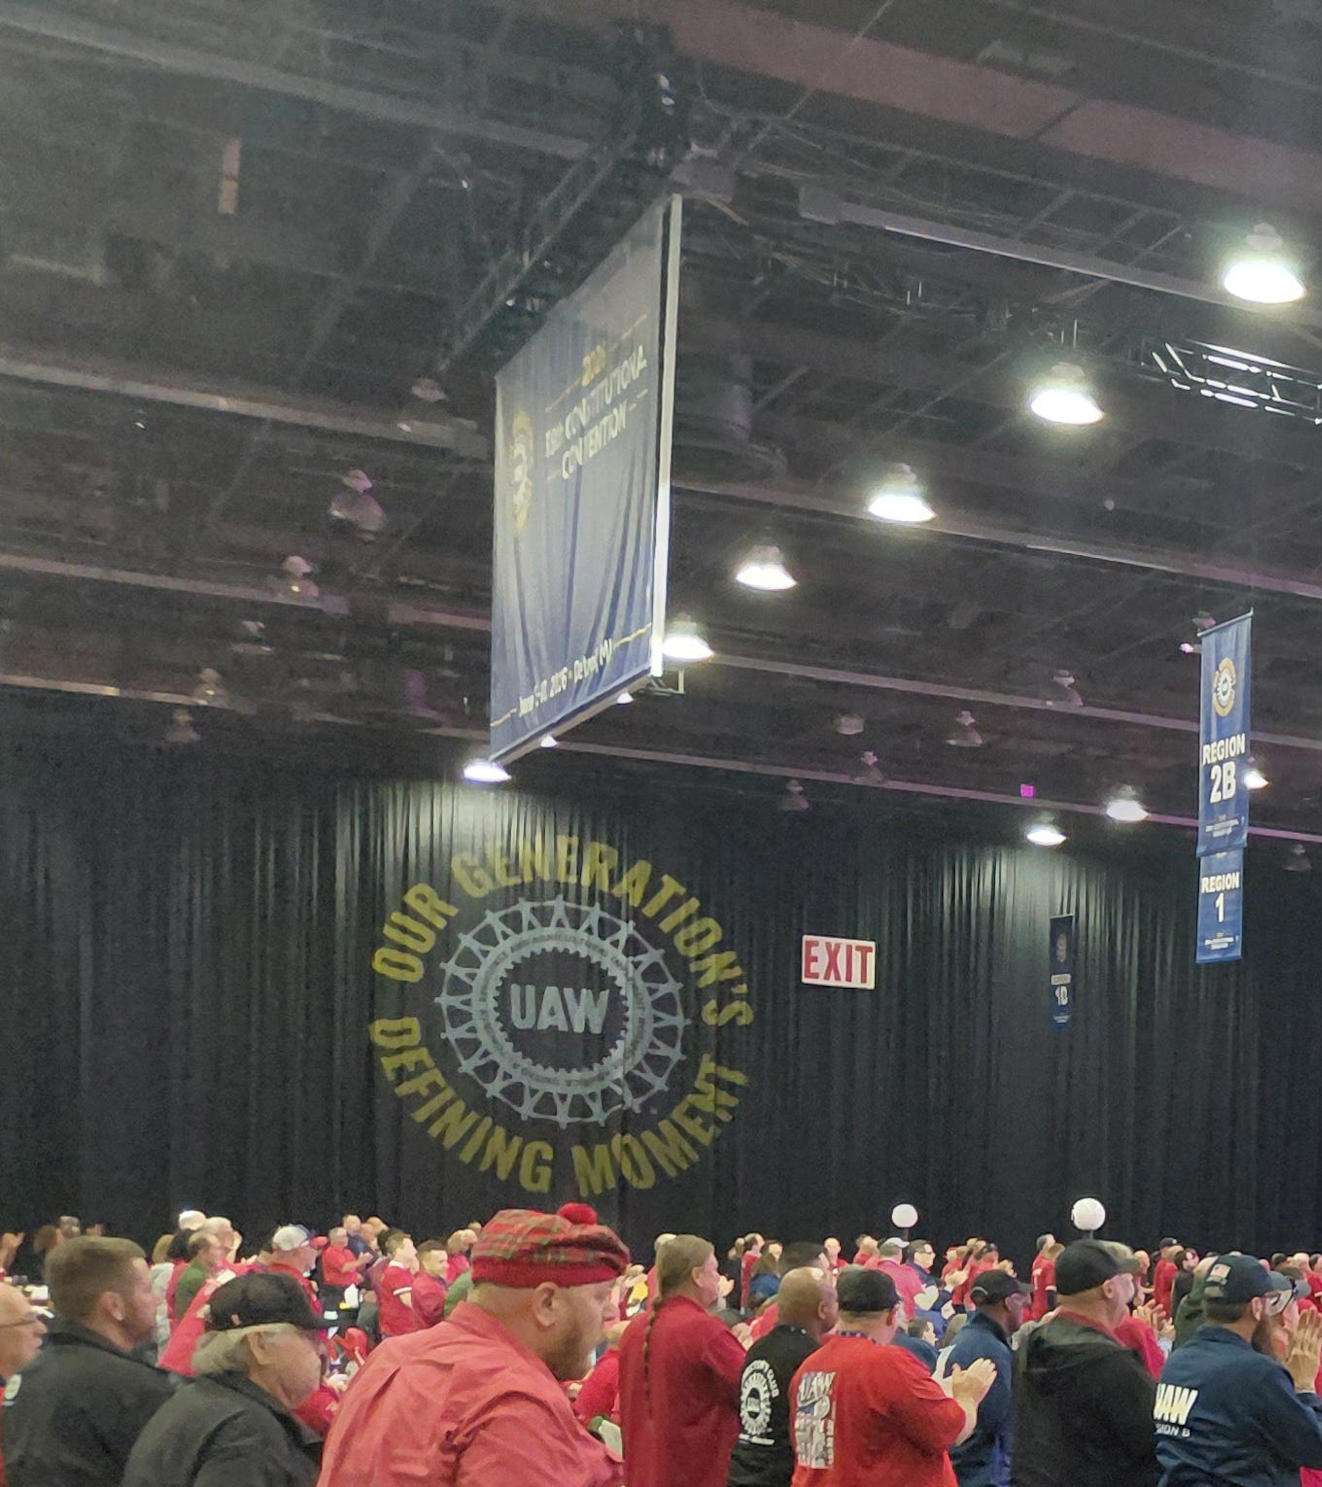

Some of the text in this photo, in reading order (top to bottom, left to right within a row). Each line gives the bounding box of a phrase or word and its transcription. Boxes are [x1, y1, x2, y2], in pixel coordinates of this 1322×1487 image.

[1202, 733, 1246, 766] REGION
[1210, 761, 1236, 803] 2B
[1201, 871, 1240, 894] REGION
[1215, 892, 1225, 923] 1
[372, 835, 756, 1029] OUR GENERATION'S
[803, 940, 873, 984] EXIT
[510, 984, 609, 1034] UAW
[369, 1016, 751, 1197] DEFINING MOMENT
